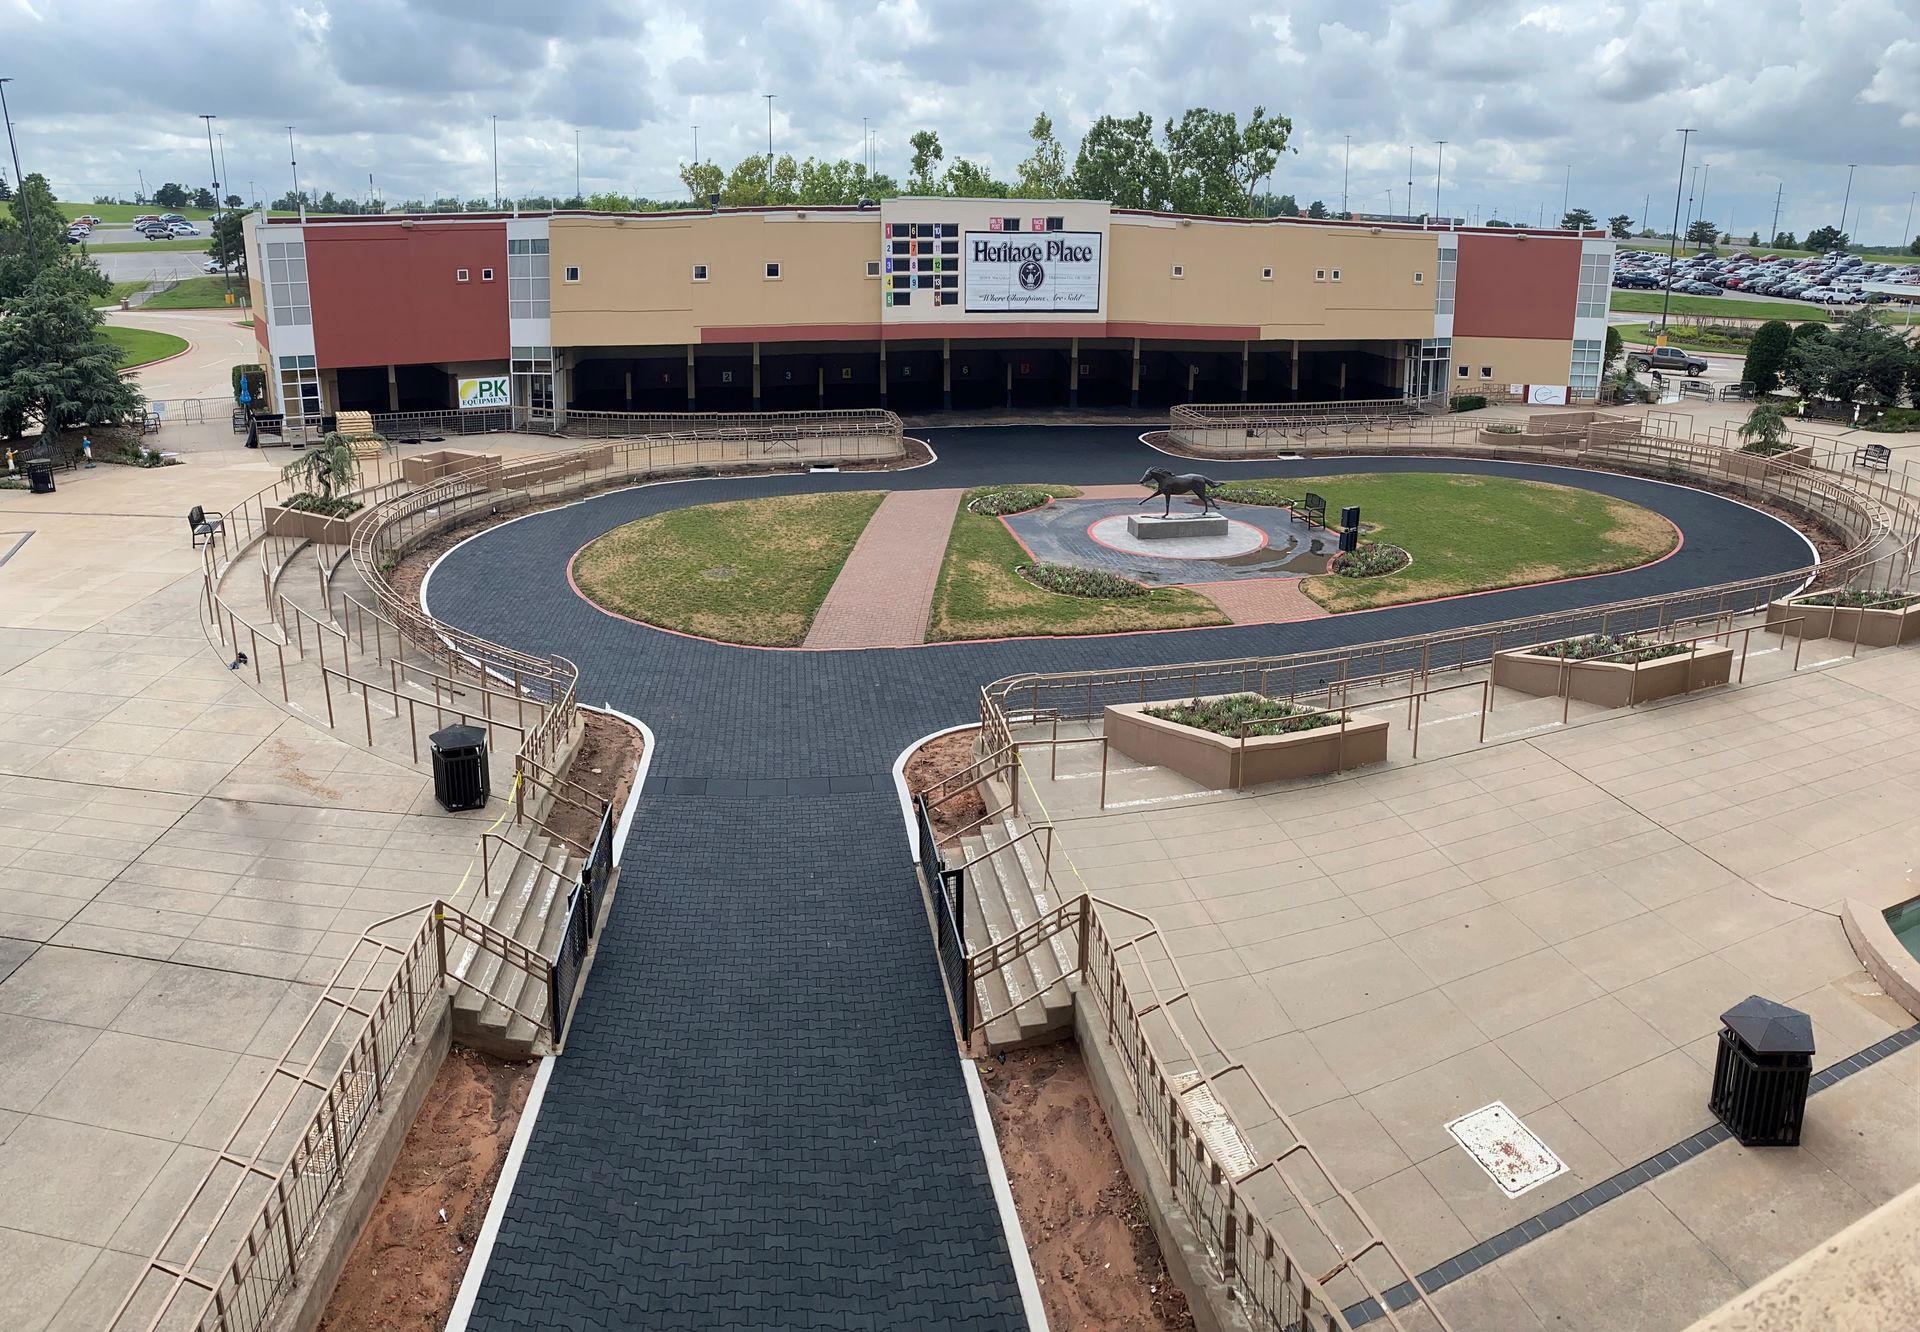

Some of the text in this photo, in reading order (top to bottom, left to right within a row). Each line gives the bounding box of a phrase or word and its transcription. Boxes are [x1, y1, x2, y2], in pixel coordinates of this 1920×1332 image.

[973, 238, 1093, 263] Heritage Place
[462, 396, 508, 406] EQUIPMENT
